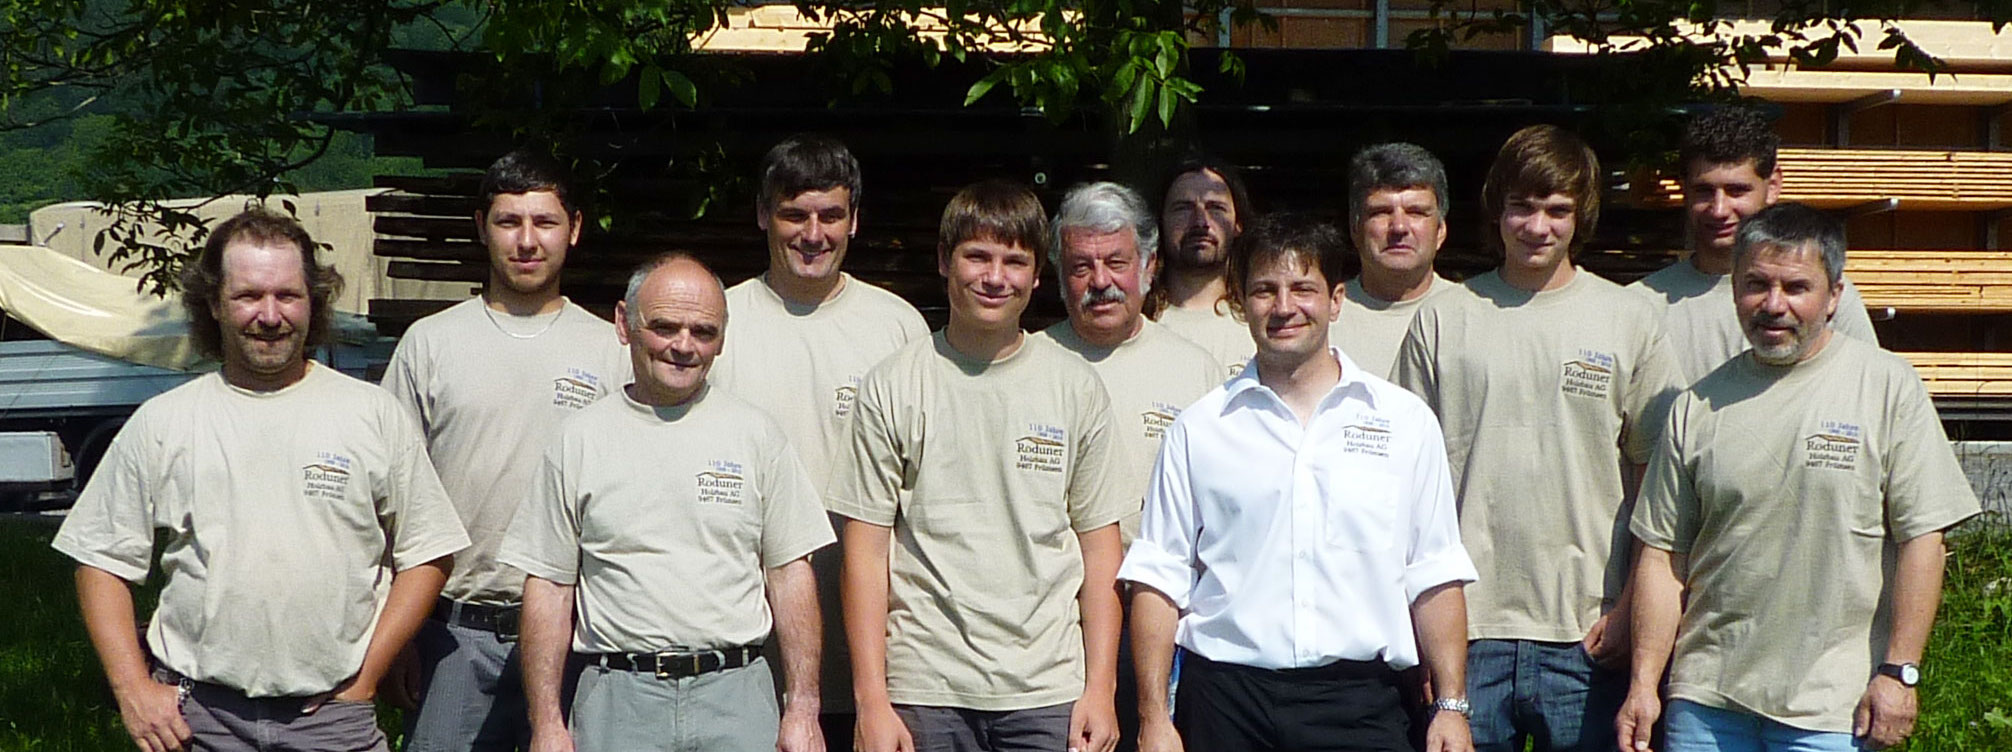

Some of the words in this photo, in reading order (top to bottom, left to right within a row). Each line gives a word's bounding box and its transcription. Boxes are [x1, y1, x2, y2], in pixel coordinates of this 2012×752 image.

[1564, 366, 1611, 384] Roduner
[555, 382, 597, 400] Roduner
[1343, 429, 1392, 443] Roduner
[1016, 442, 1064, 457] Roduner
[1806, 440, 1860, 454] Roduner
[1049, 456, 1061, 465] AG
[1841, 454, 1855, 463] AG
[304, 470, 350, 485] Roduner
[697, 477, 744, 490] Roduner
